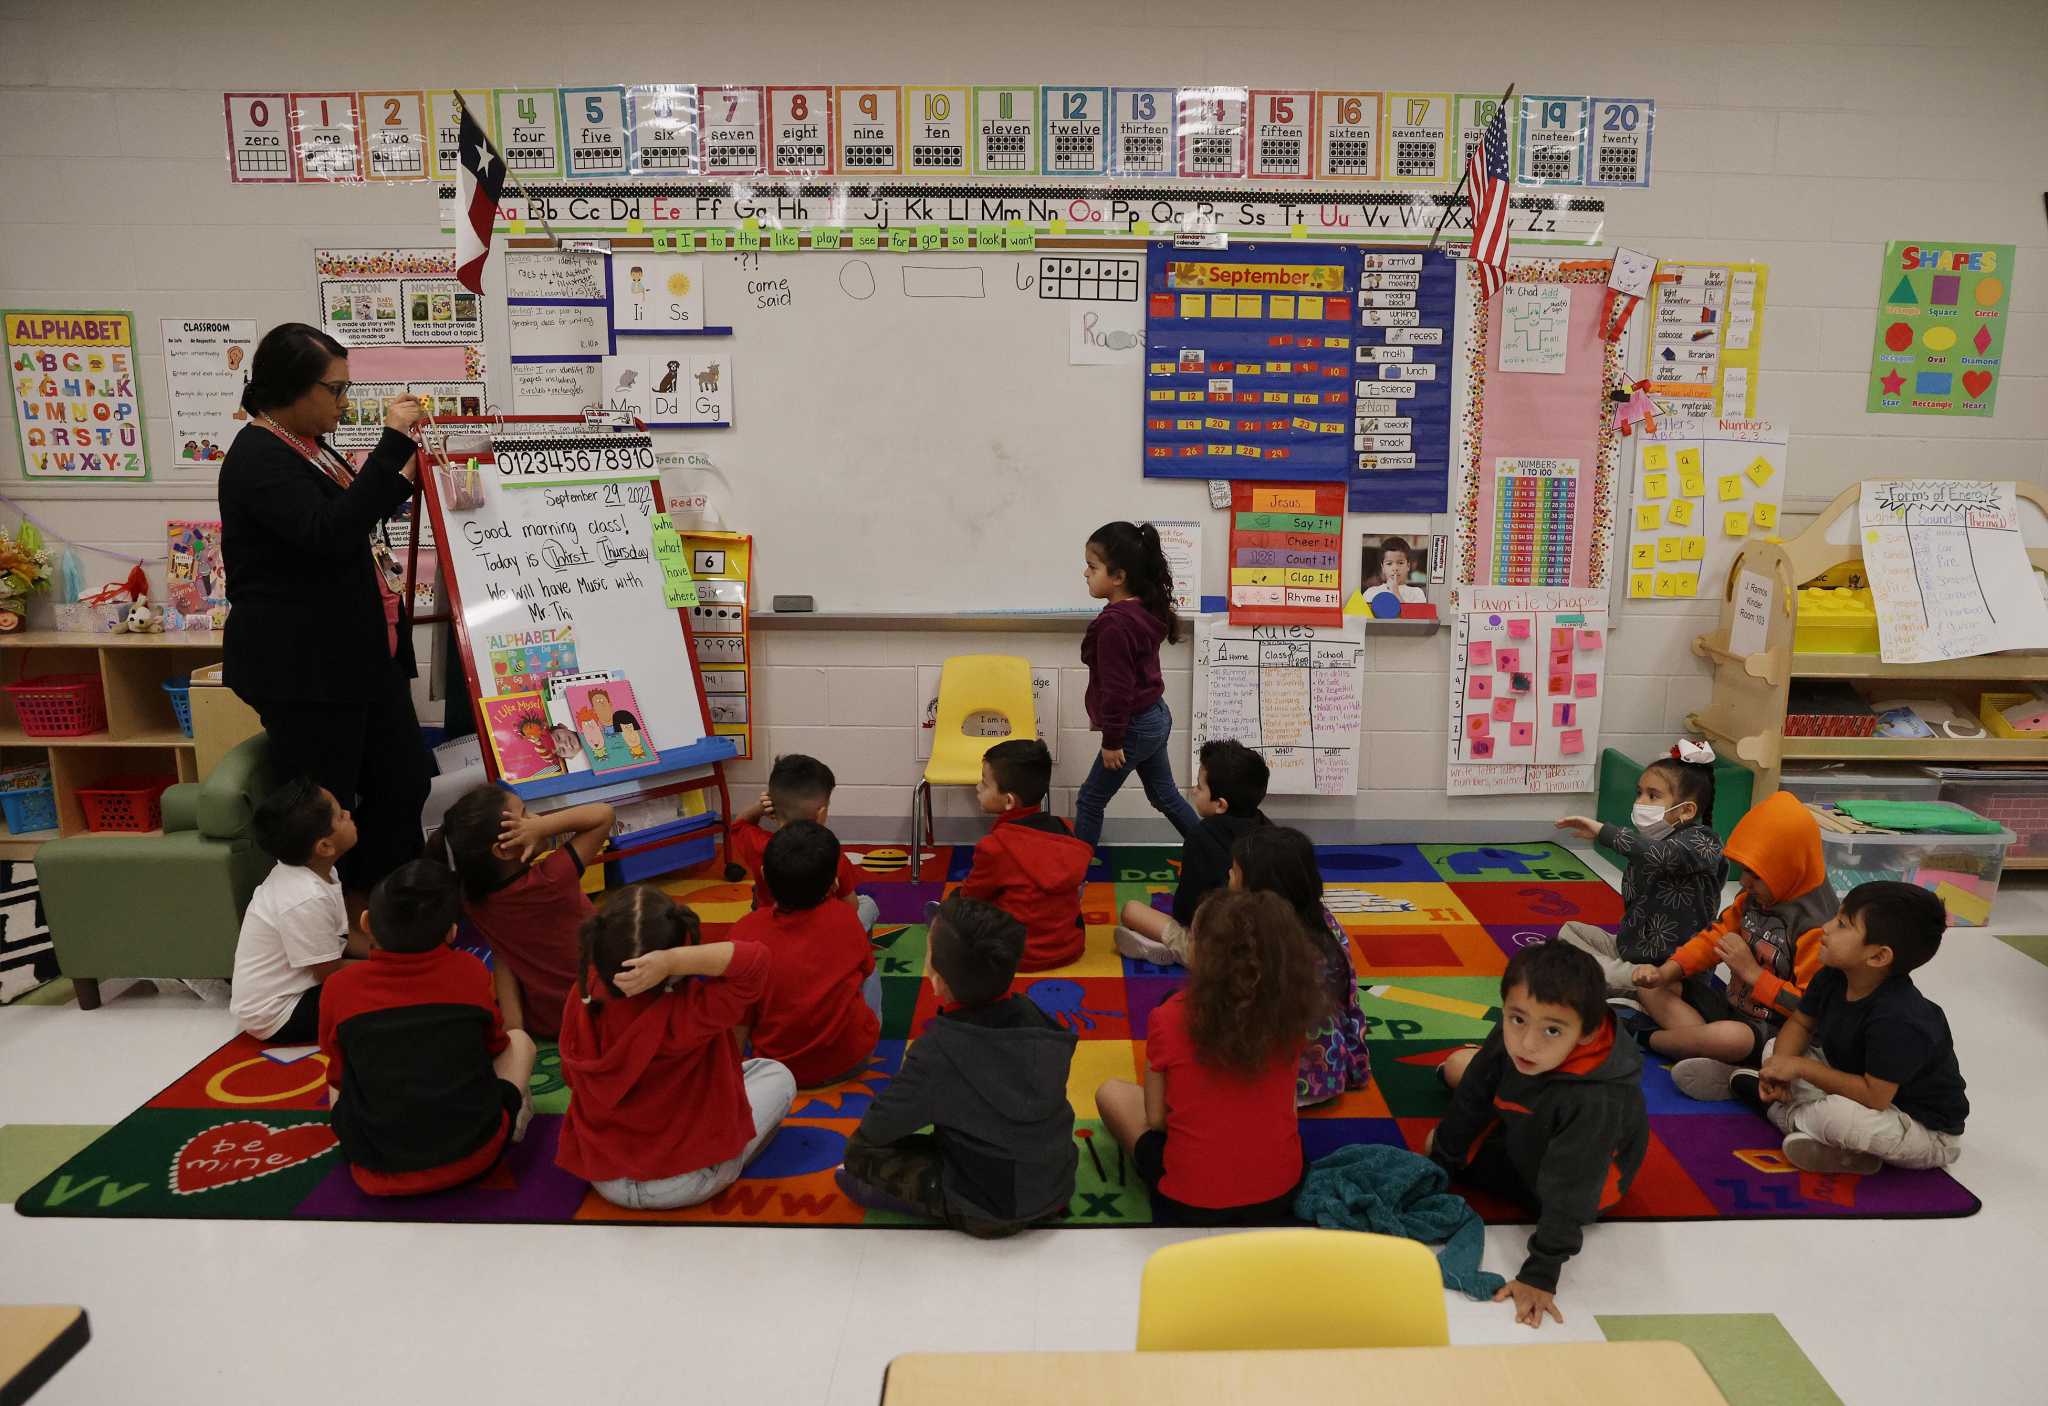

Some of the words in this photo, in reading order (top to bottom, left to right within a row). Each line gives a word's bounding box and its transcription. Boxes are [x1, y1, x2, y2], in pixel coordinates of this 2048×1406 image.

[584, 97, 604, 124] 5
[791, 94, 808, 121] 8
[924, 94, 950, 120] 10
[1062, 93, 1087, 119] 12
[1132, 94, 1156, 120] 13
[1269, 96, 1294, 124] 15
[1337, 98, 1362, 125] 16
[1406, 99, 1430, 126] 17
[1604, 104, 1639, 131] 20
[513, 127, 546, 143] four
[654, 128, 675, 141] six
[711, 129, 754, 141] seven
[783, 127, 818, 142] eight
[854, 127, 884, 139] nine
[925, 125, 950, 139] ten
[982, 122, 1031, 135] eleven
[1050, 121, 1100, 135] twelve
[1121, 123, 1168, 134] thirteen
[1261, 125, 1303, 137] fifteen
[1329, 129, 1370, 139] sixteen
[1392, 129, 1444, 140] seventeen
[244, 133, 280, 147] zero
[582, 130, 611, 143] five
[1602, 134, 1639, 145] twenty
[569, 199, 600, 220] Cc
[610, 199, 640, 220] Dd
[653, 199, 681, 220] Ee
[696, 199, 722, 220] Ff
[981, 199, 1021, 221] Mm
[1068, 199, 1102, 222] Oo
[1320, 205, 1350, 228] Uu
[680, 234, 690, 247] I
[711, 233, 723, 246] to
[738, 231, 757, 245] the
[775, 231, 795, 245] like
[816, 230, 838, 246] play
[859, 235, 876, 245] see
[892, 232, 907, 247] for
[922, 234, 937, 247] go
[979, 232, 999, 245] look
[1901, 245, 1998, 273] SHAPES
[1016, 262, 1034, 291] 6
[1210, 267, 1310, 287] September
[748, 278, 789, 294] come
[757, 292, 791, 309] said
[670, 304, 689, 321] Ss
[15, 319, 122, 341] ALPHABET
[183, 322, 230, 332] CLASSROOM
[449, 321, 476, 329] provide
[1409, 332, 1438, 340] recess
[1657, 331, 1683, 339] caboose
[1406, 367, 1428, 375] lunch
[1381, 384, 1412, 393] science
[656, 398, 678, 415] Dd
[696, 397, 720, 422] Gg
[1719, 419, 1772, 431] Numbers
[1517, 460, 1557, 469] NUMBERS
[543, 489, 598, 508] September
[603, 483, 620, 504] 29
[627, 486, 651, 504] 2022
[1890, 487, 1929, 503] Forms
[463, 519, 512, 546] Good
[522, 520, 577, 544] morning
[588, 513, 630, 535] class!
[1294, 518, 1314, 529] Say
[658, 542, 681, 553] what
[1288, 536, 1320, 547] Cheer
[476, 551, 521, 575] Today
[526, 553, 539, 567] is
[596, 537, 649, 566] Thursday
[704, 555, 715, 568] 6
[1286, 554, 1317, 565] Count
[665, 565, 688, 578] have
[1290, 571, 1314, 584] Clap
[487, 583, 506, 599] We
[514, 581, 535, 598] will
[538, 578, 571, 597] have
[577, 578, 608, 593] Music
[614, 575, 643, 590] with
[669, 590, 696, 603] where
[1287, 592, 1321, 604] Rhyme
[1472, 593, 1538, 612] Favorite
[490, 627, 557, 649] ALPHABET
[1318, 650, 1344, 659] School
[212, 1137, 265, 1158] be
[186, 1151, 293, 1172] mine
[43, 1175, 150, 1208] Vv
